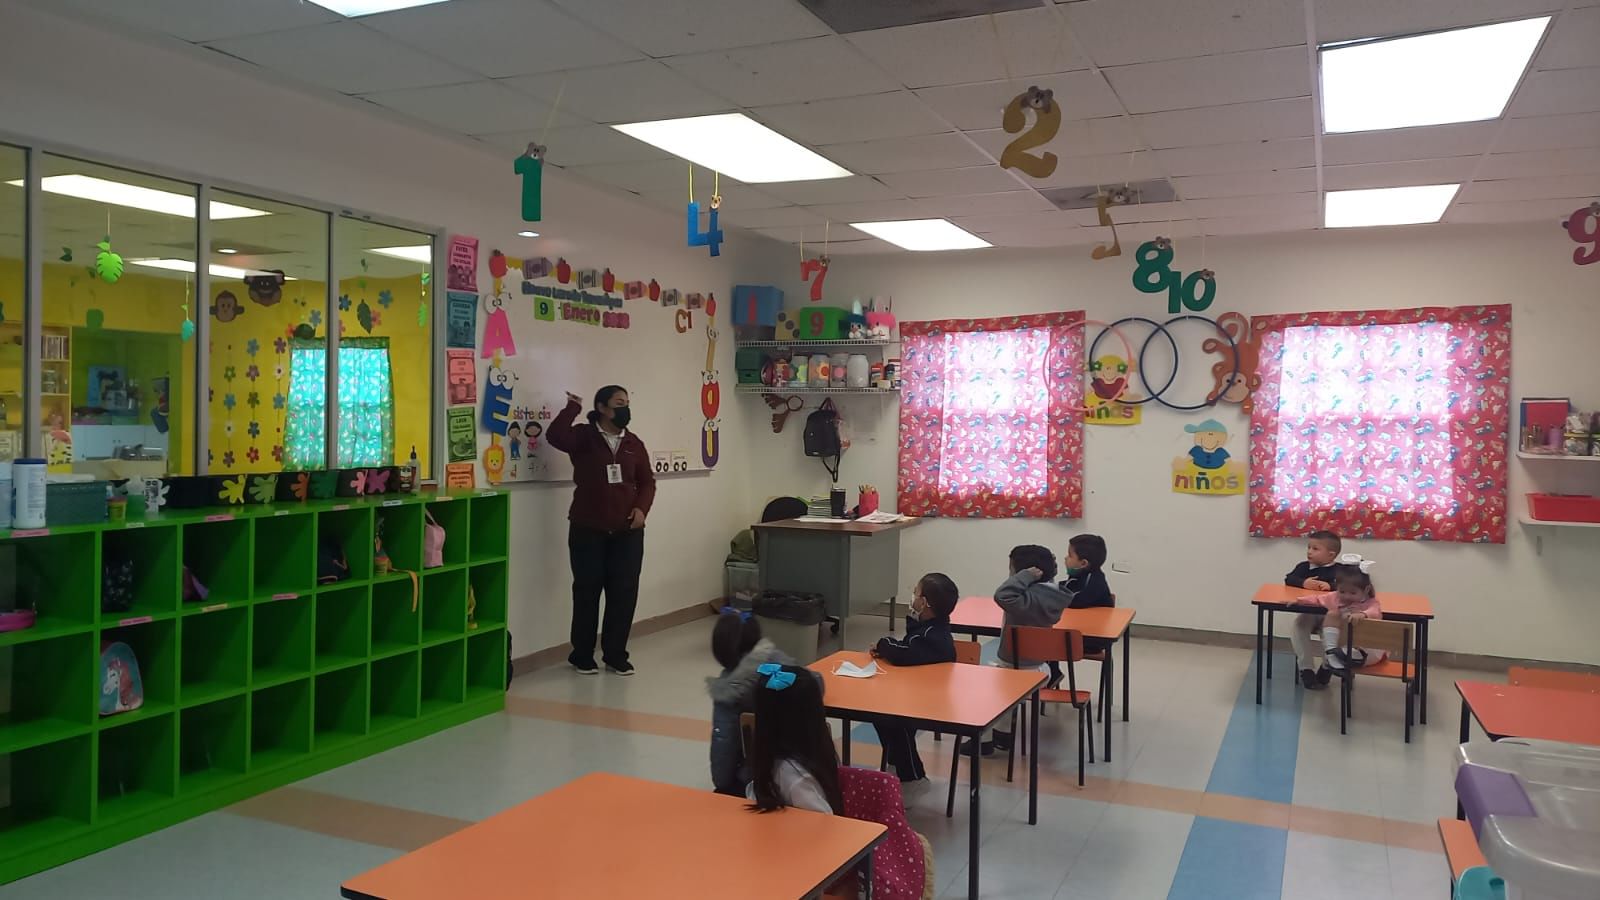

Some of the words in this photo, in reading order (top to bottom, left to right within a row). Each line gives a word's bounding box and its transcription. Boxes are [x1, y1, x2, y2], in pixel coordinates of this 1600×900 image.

[1000, 90, 1061, 178] 2
[514, 156, 543, 222] 1
[687, 202, 723, 256] 4
[800, 259, 829, 301] 7
[1132, 240, 1174, 293] 8
[1168, 270, 1216, 313] 10
[481, 308, 516, 358] A
[539, 302, 548, 315] 9
[563, 302, 600, 321] Enero
[809, 312, 824, 336] 9
[482, 372, 514, 436] E
[1174, 472, 1239, 490] niños
